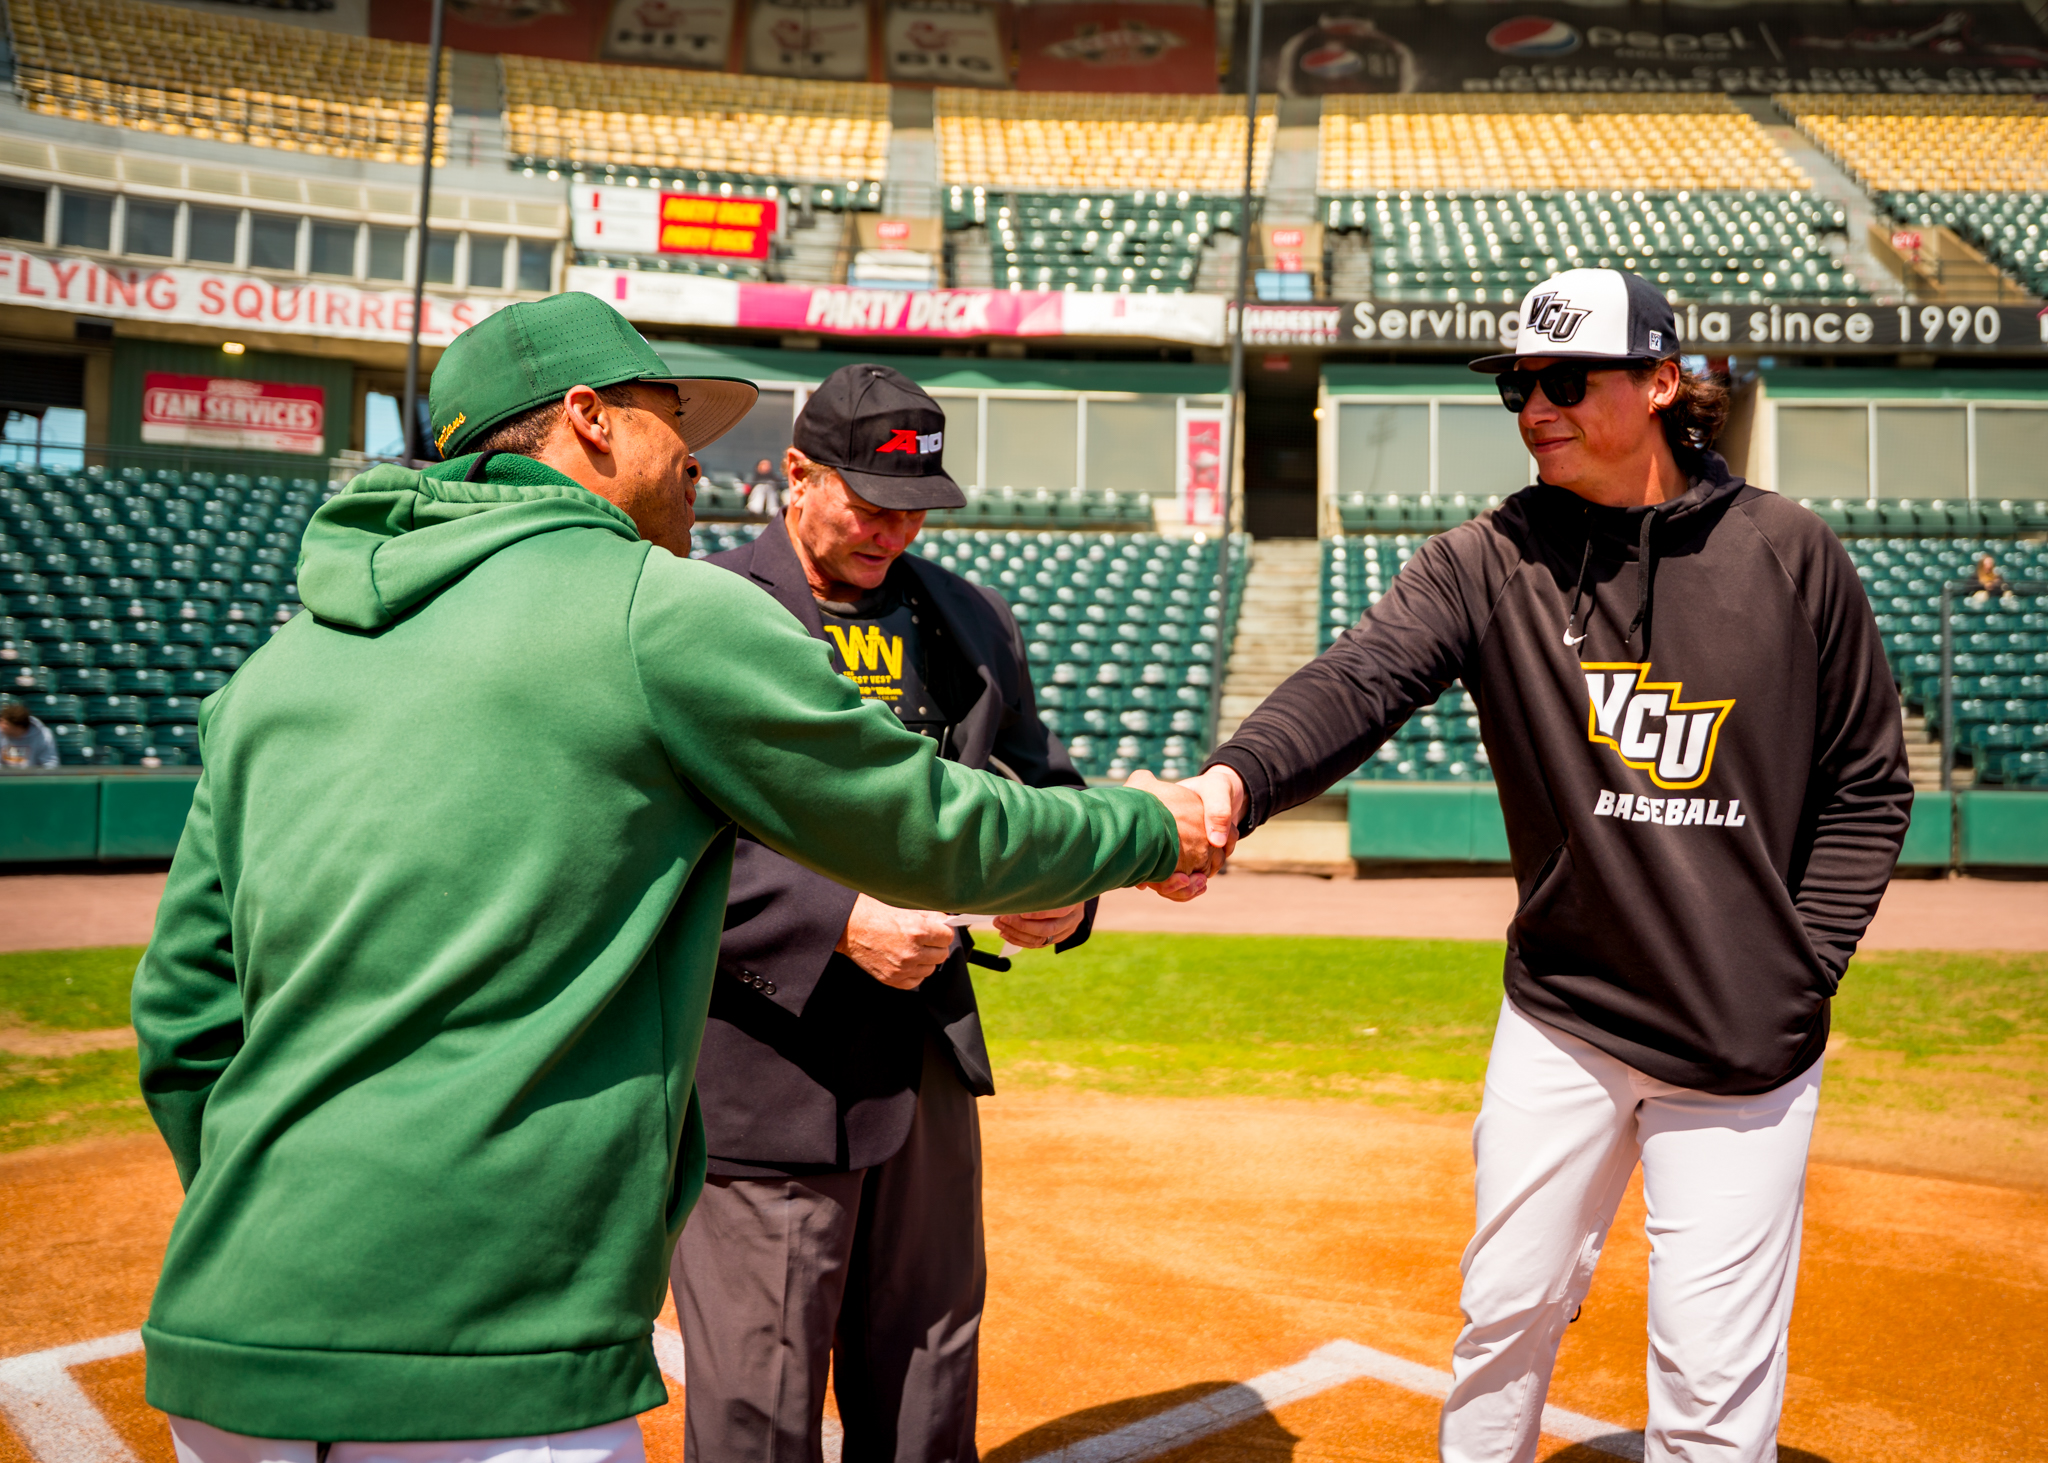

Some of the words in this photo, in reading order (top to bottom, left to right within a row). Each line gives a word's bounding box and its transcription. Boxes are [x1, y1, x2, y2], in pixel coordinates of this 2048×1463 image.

[662, 197, 717, 224] PARTY
[716, 202, 764, 226] DECK
[661, 225, 712, 249] PARTY
[711, 228, 755, 252] DECK
[199, 276, 475, 337] SQUIRRELS
[806, 288, 907, 330] PARTY
[906, 291, 990, 332] DECK
[1353, 301, 1522, 348] Serving
[1526, 292, 1592, 343] VCU
[1749, 304, 1874, 343] since
[1897, 305, 2001, 344] 1990
[153, 391, 199, 418] FAN
[203, 397, 315, 428] SERVICES
[869, 675, 892, 684] VEST
[1581, 664, 1730, 788] VCU
[1593, 789, 1747, 827] BASEBALL
